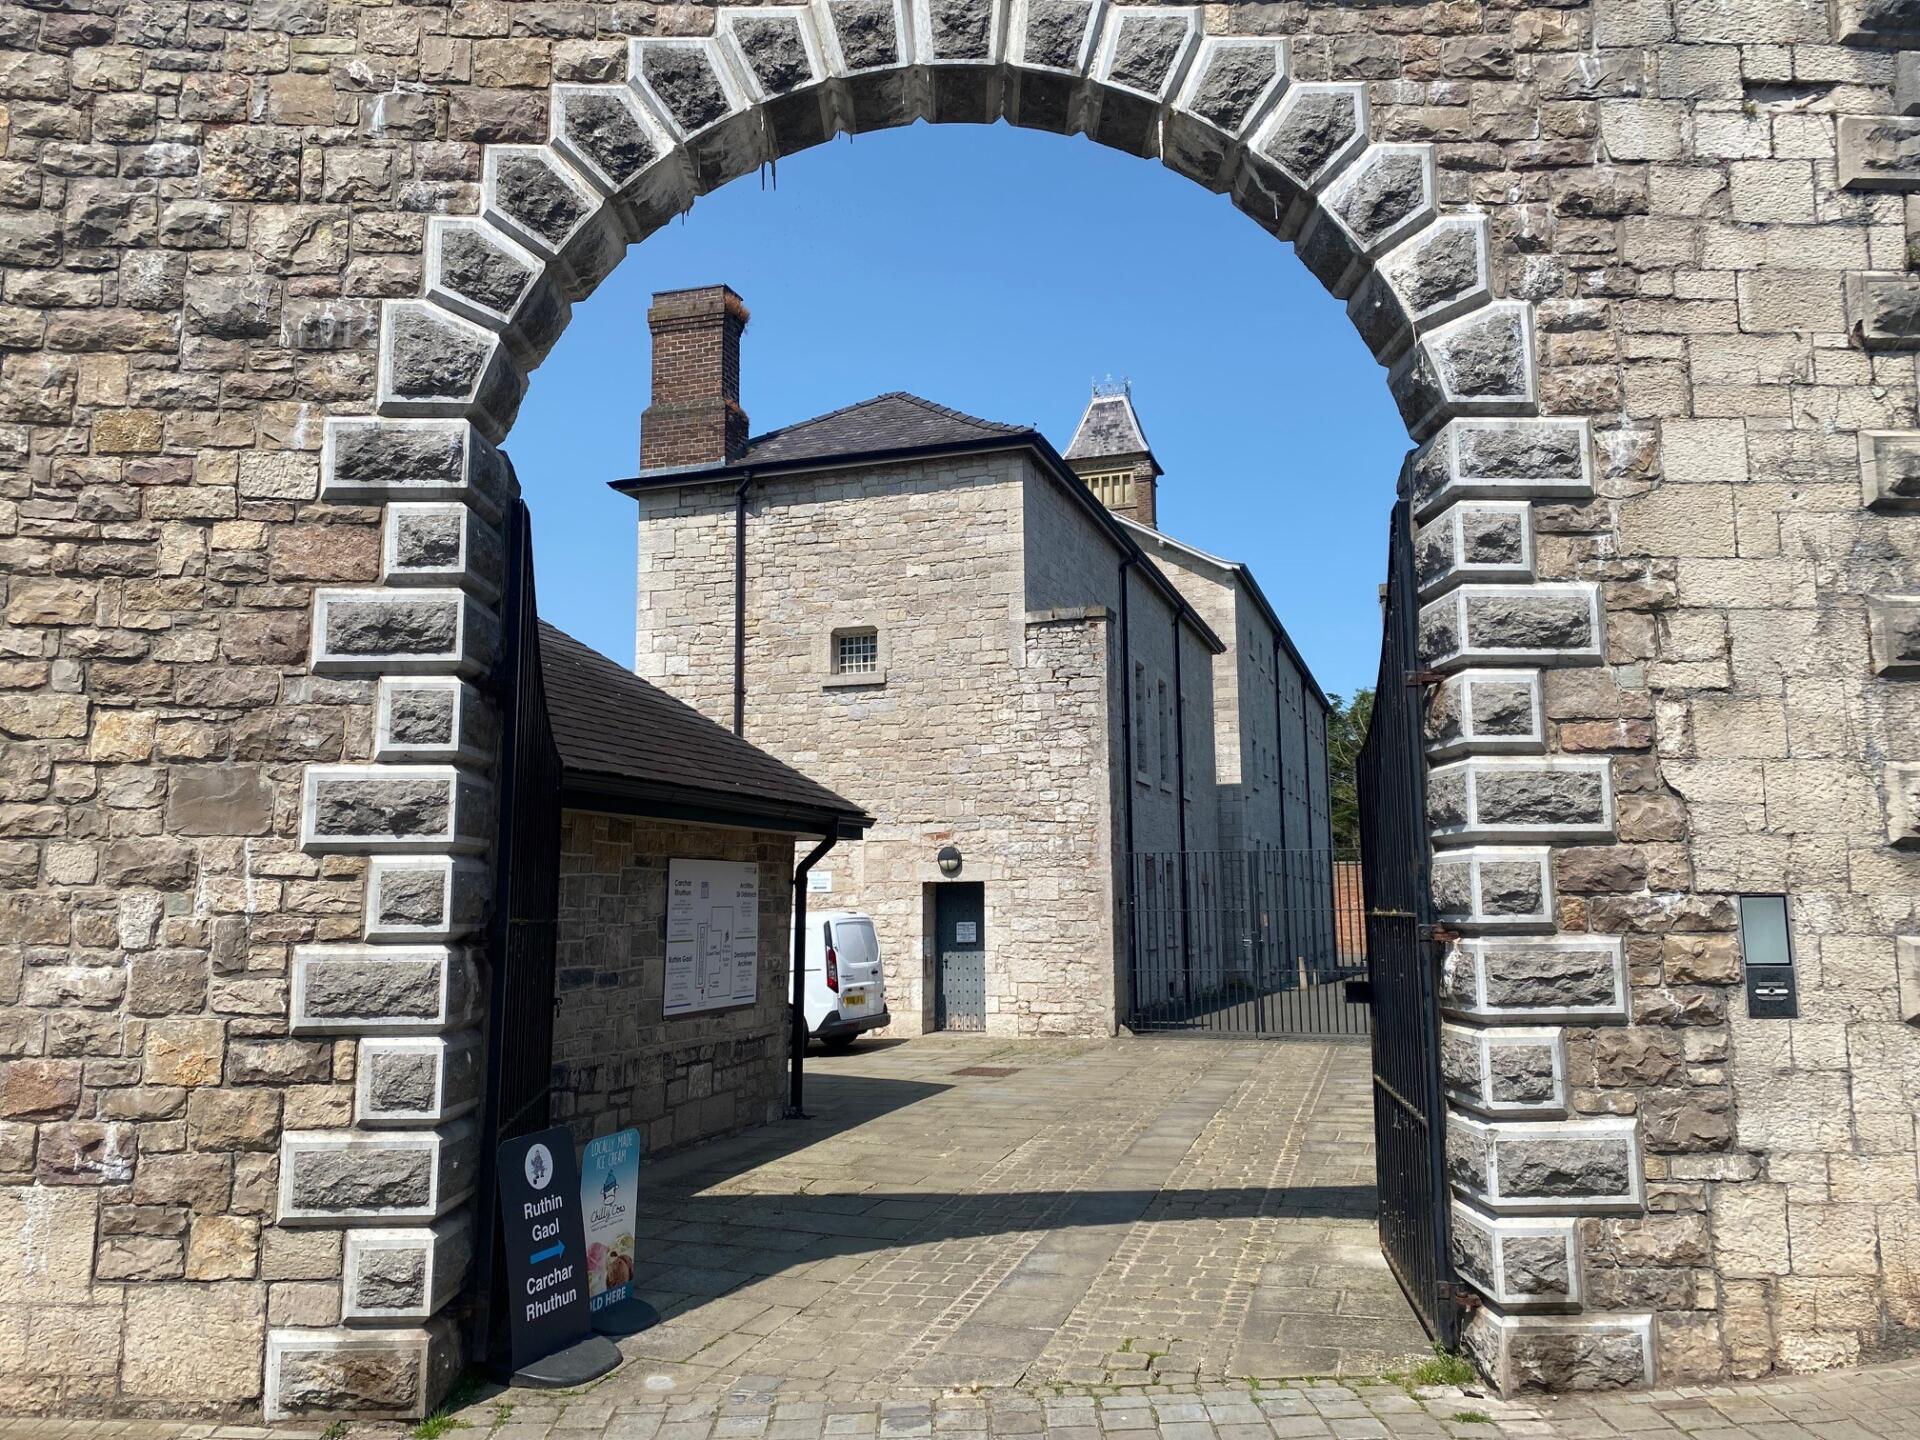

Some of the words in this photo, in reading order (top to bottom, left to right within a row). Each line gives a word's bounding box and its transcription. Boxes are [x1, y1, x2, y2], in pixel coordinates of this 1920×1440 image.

[591, 1138, 615, 1157] LOCALLY
[617, 1132, 633, 1150] MADE
[596, 1154, 606, 1169] ICE
[608, 1149, 627, 1167] CREAM
[523, 1194, 563, 1220] Ruthin
[591, 1206, 610, 1223] Chilly
[532, 1217, 560, 1242] Gaol
[526, 1264, 574, 1295] Carchar
[526, 1288, 577, 1322] Rhuthun
[605, 1286, 627, 1306] HERE
